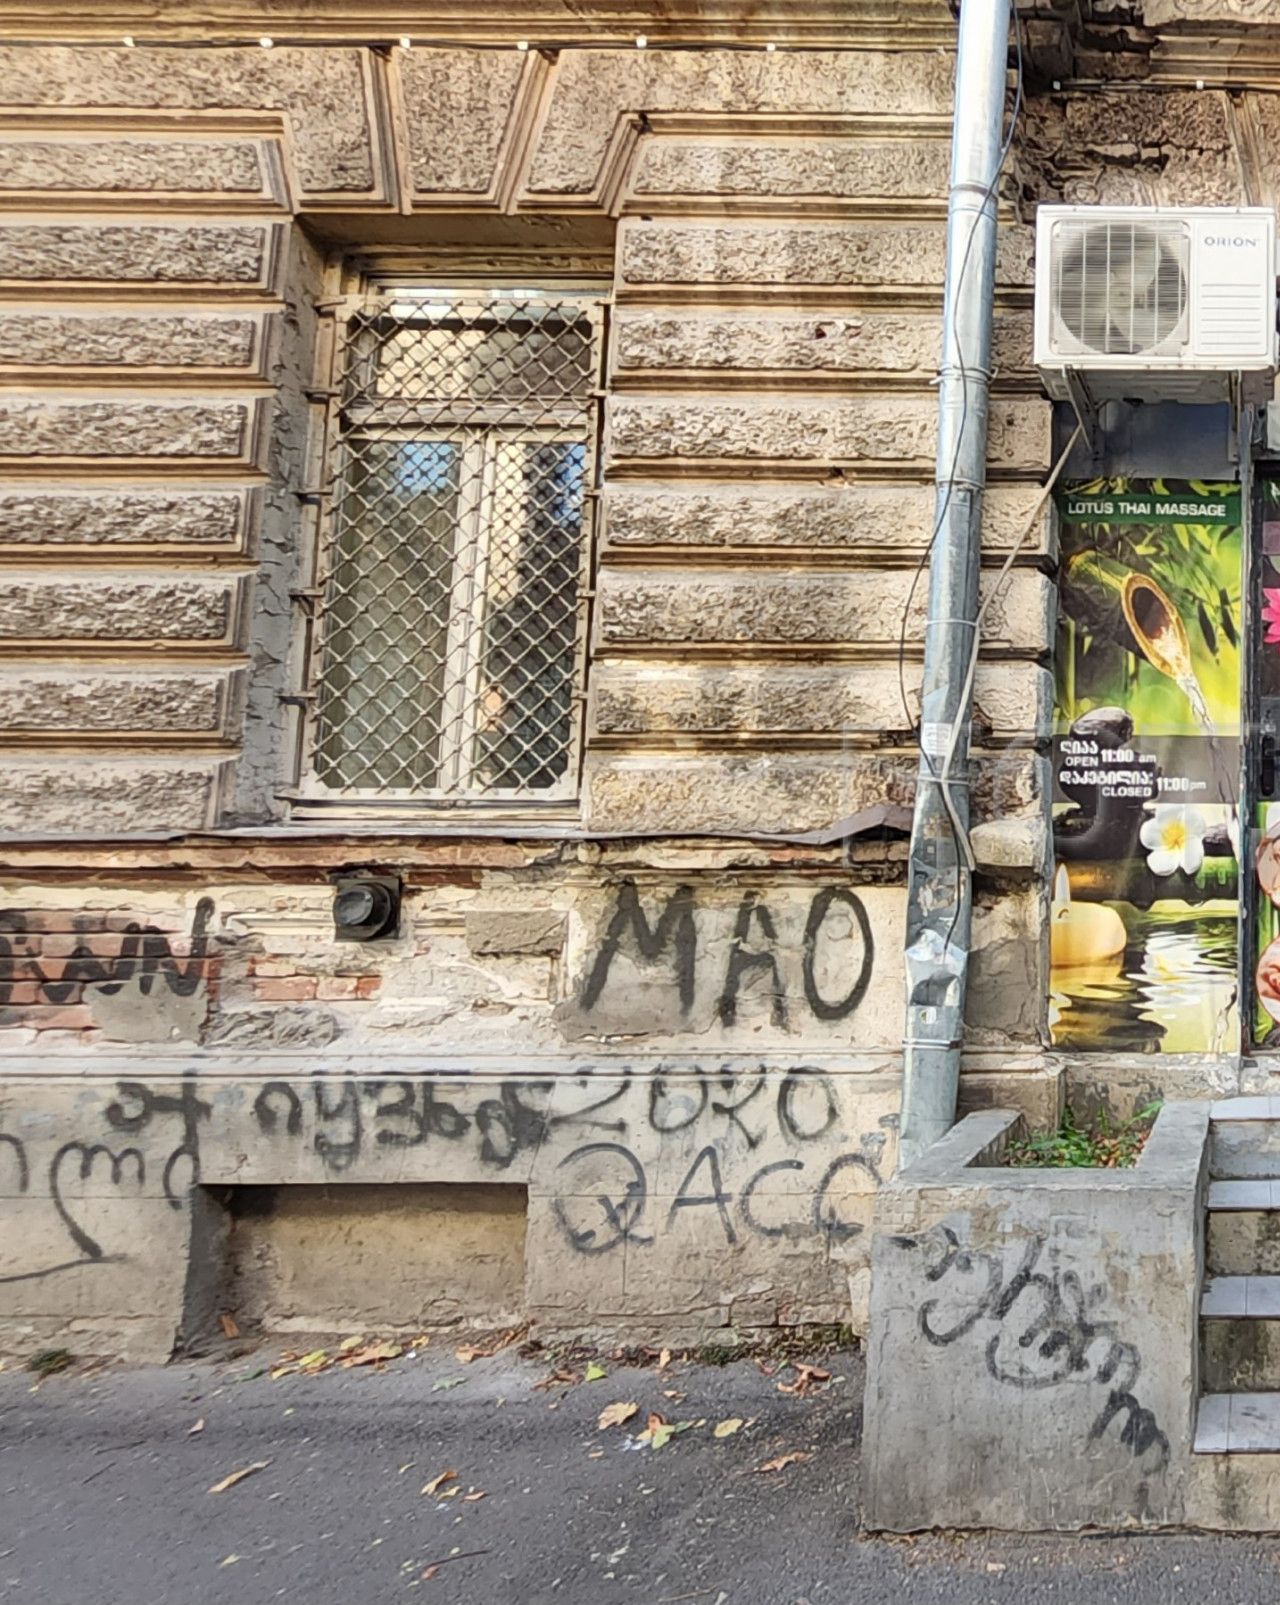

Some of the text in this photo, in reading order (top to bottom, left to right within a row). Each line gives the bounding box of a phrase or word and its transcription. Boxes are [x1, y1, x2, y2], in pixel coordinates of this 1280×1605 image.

[1204, 235, 1257, 248] ORION
[1067, 501, 1227, 517] LOTUS THAI MASSAGE
[1065, 756, 1099, 767] OPEN
[1101, 749, 1135, 763] 11:00
[1157, 776, 1207, 792] 11:00 pm
[1102, 786, 1153, 797] CLOSED
[580, 876, 874, 1027] MAO
